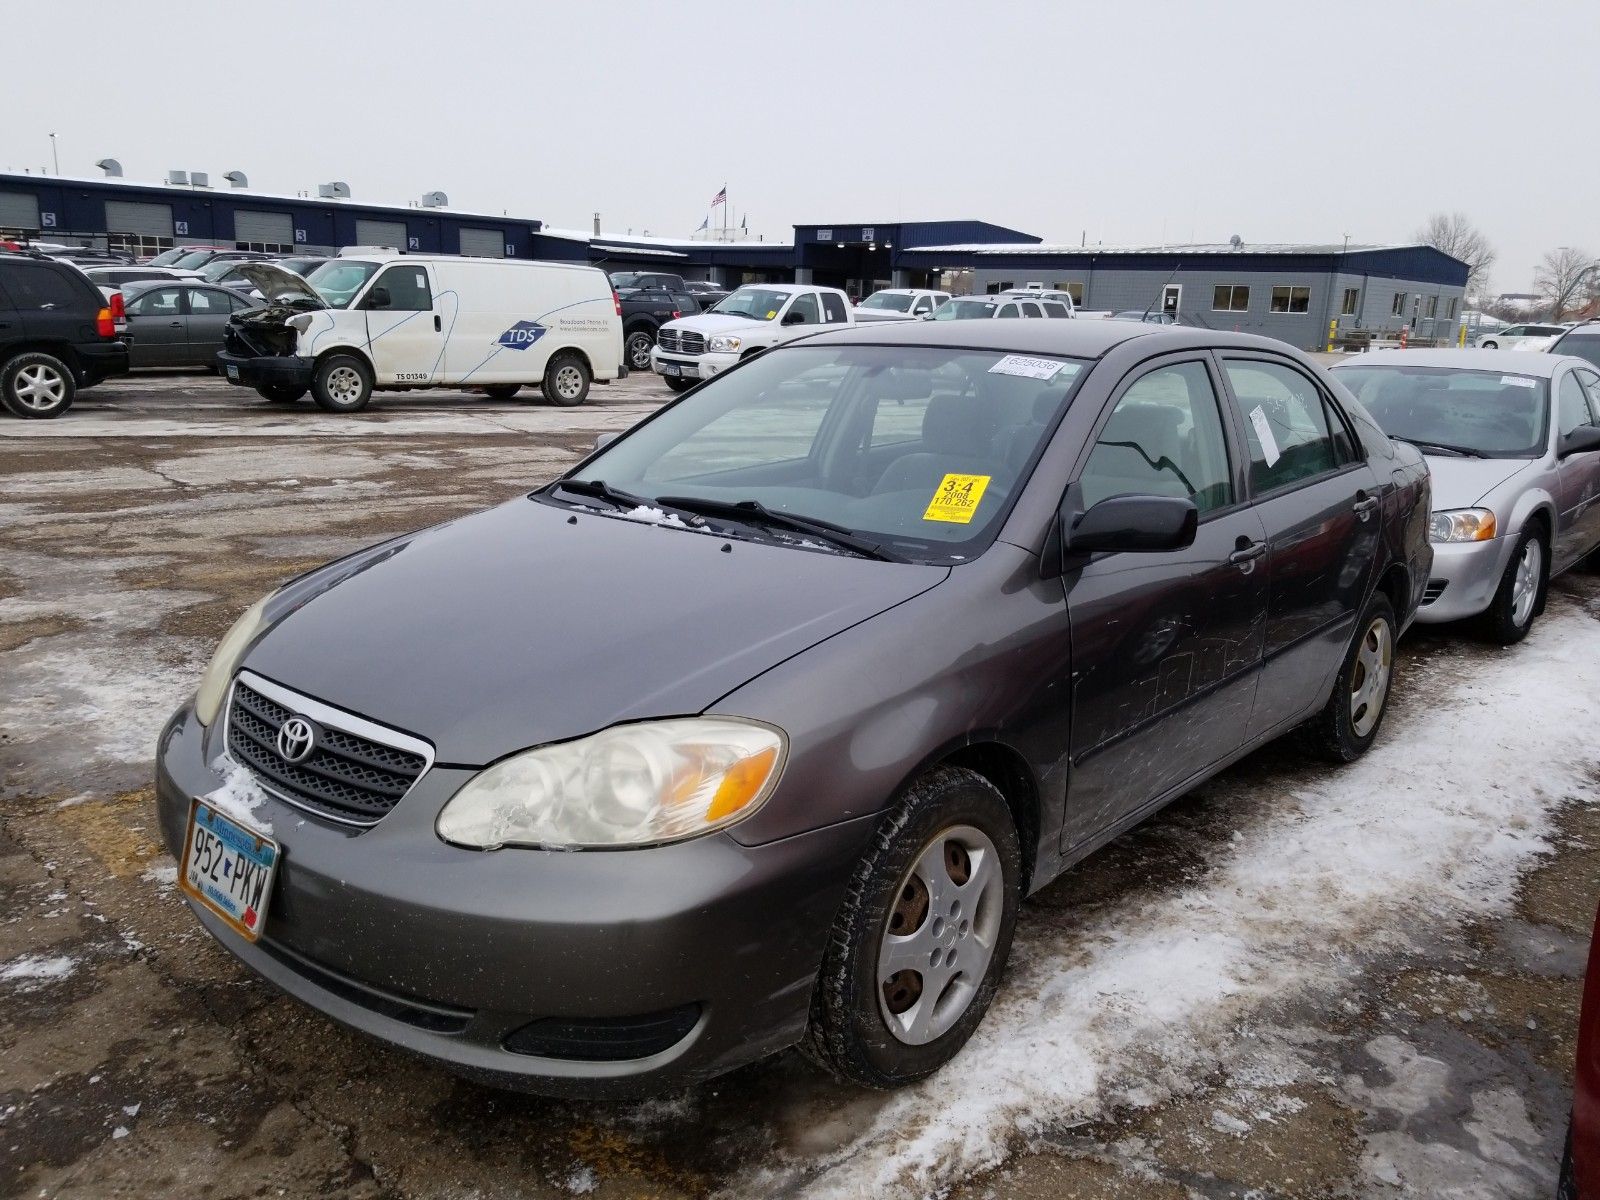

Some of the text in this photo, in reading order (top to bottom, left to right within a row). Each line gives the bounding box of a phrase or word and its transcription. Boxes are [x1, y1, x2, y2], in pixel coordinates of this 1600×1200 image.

[44, 213, 54, 226] 5
[177, 222, 187, 234] 4
[297, 230, 305, 241] 3
[410, 238, 418, 248] 2
[509, 329, 536, 343] TDS
[943, 491, 970, 501] 2008
[194, 828, 268, 912] 952 PKW
